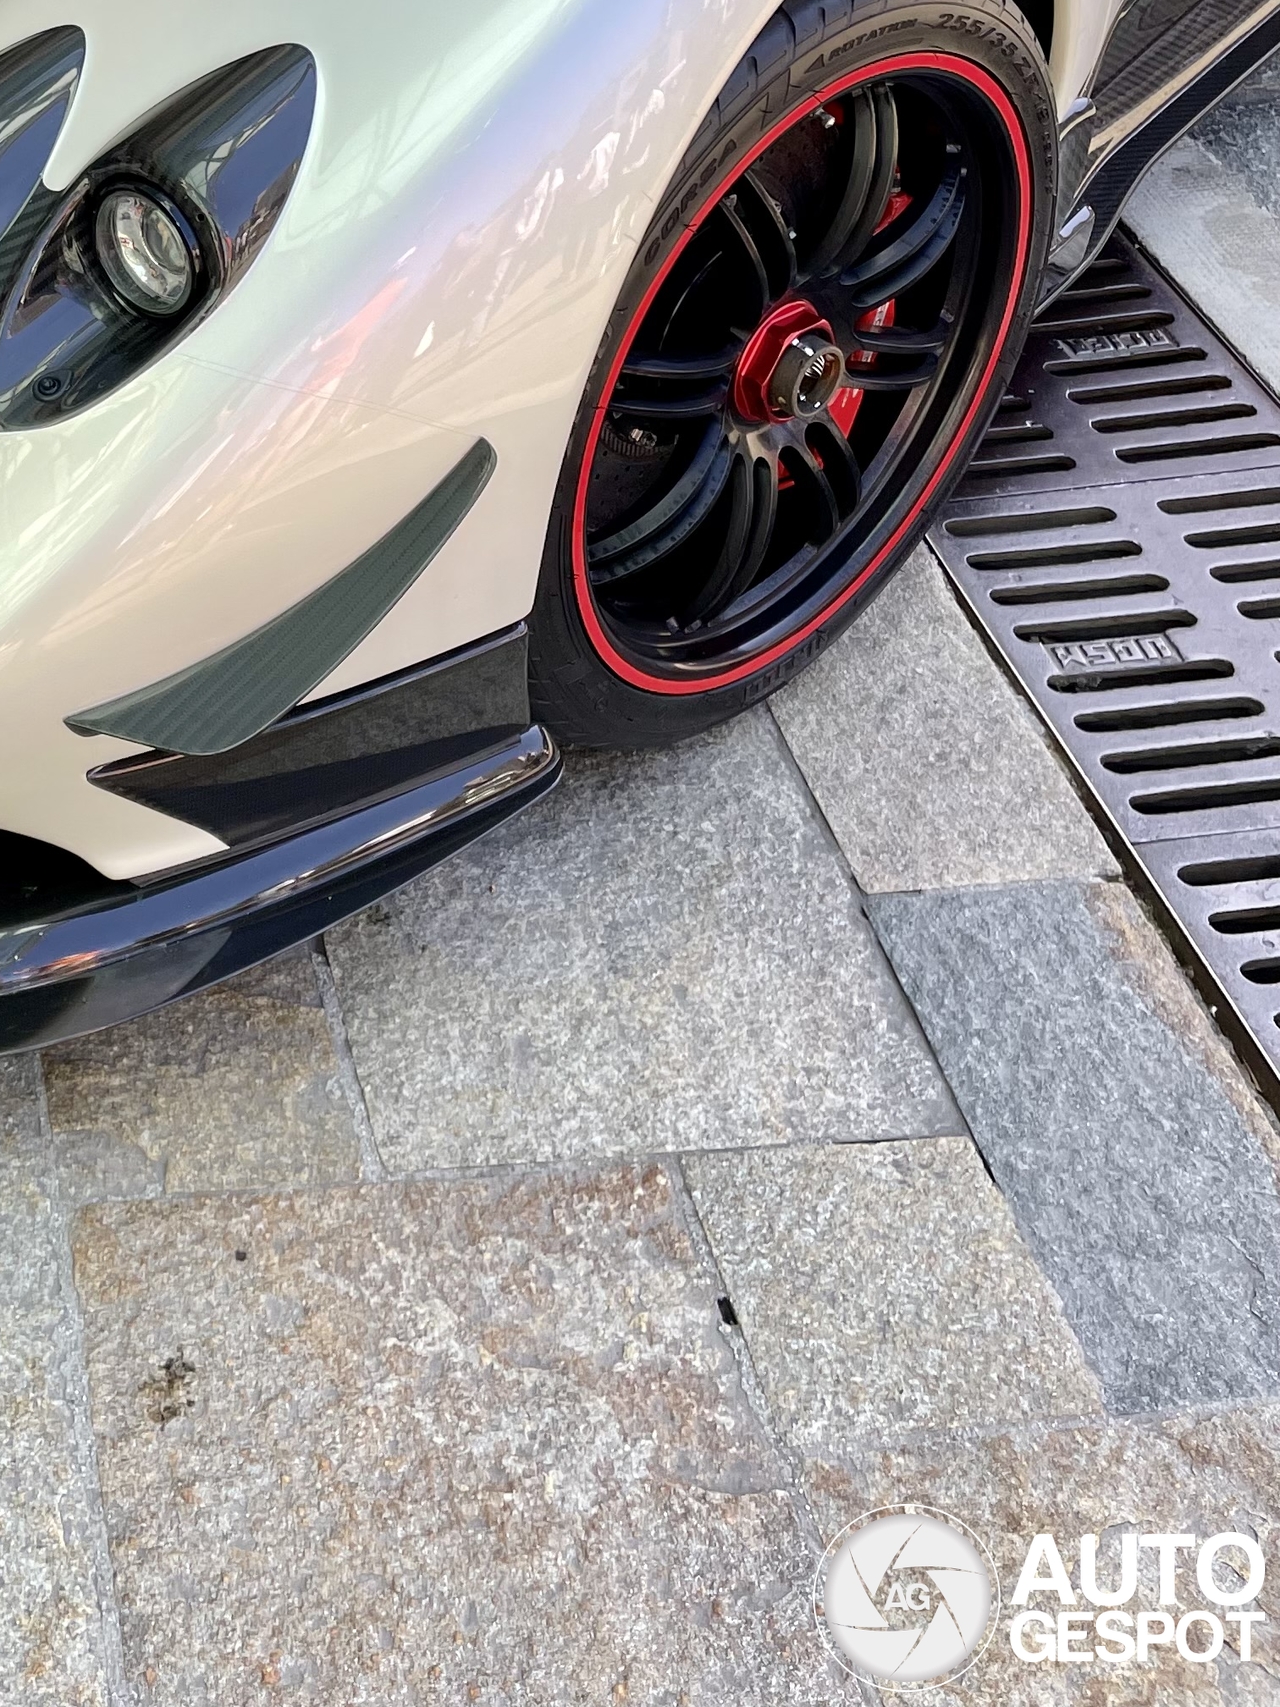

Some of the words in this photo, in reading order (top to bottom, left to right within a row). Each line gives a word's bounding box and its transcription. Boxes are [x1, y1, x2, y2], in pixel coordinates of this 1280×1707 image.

[828, 17, 918, 62] ROTATION
[933, 12, 1019, 58] 255/35
[643, 138, 737, 267] CORSA
